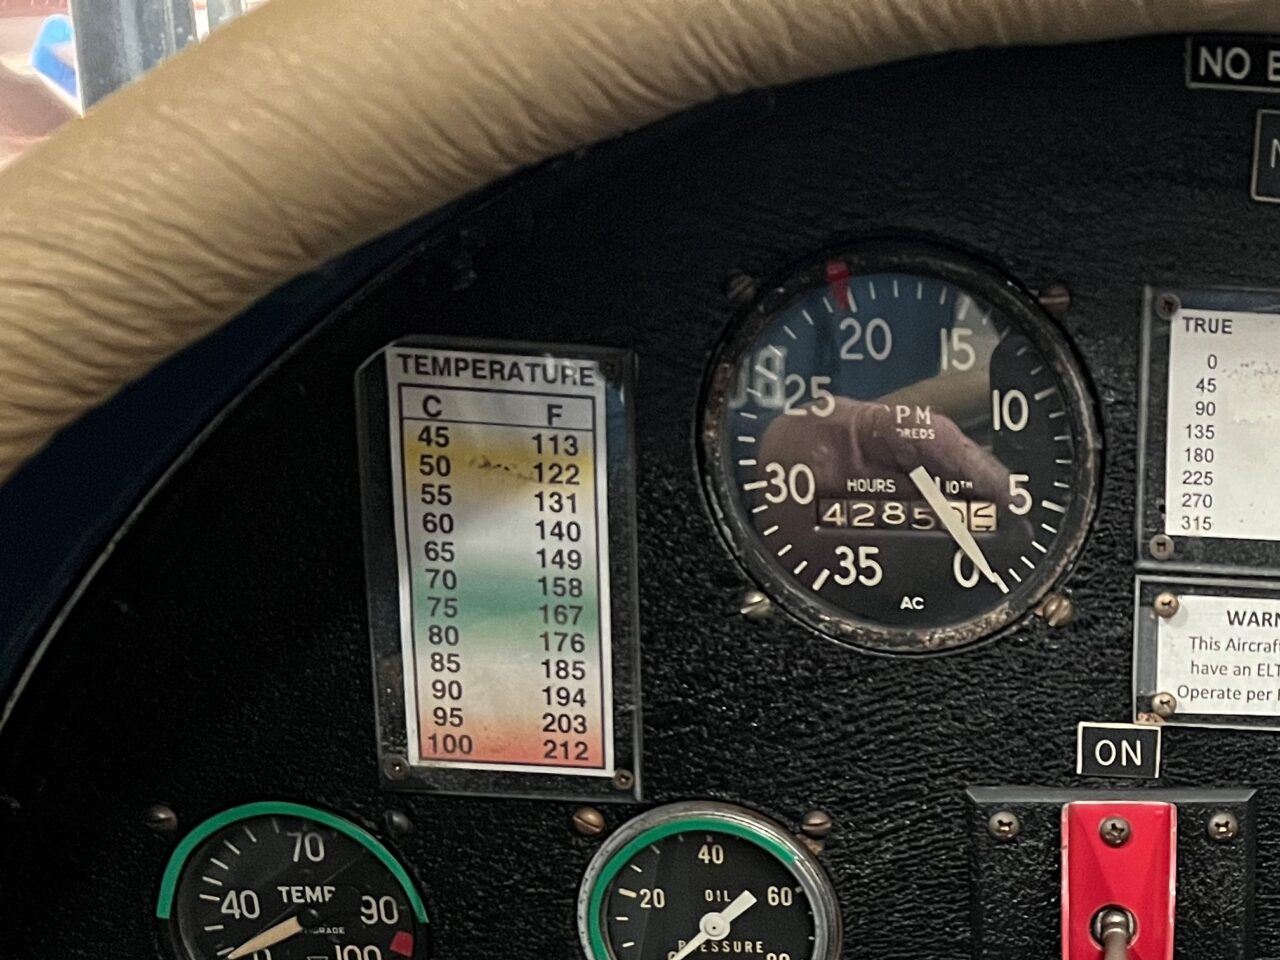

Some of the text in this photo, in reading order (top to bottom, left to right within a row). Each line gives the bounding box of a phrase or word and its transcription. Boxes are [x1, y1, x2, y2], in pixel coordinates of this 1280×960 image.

[1200, 47, 1251, 79] NO
[1182, 316, 1233, 334] TRUE
[840, 318, 892, 360] 20
[941, 328, 976, 371] 15
[398, 354, 594, 387] TEMPERATURE
[1207, 354, 1217, 369] 0
[784, 374, 835, 417] 25
[1196, 378, 1217, 393] 45
[422, 395, 563, 425] C F
[883, 404, 931, 425] PM
[992, 389, 1029, 431] 10
[1195, 401, 1216, 416] 90
[418, 426, 579, 456] 45 113
[1185, 424, 1215, 439] 135
[1185, 448, 1214, 463] 180
[419, 455, 580, 485] 50 122
[765, 462, 816, 505] 30
[1182, 471, 1213, 486] 225
[421, 484, 577, 514] 55 131
[847, 479, 896, 493] HOURS
[1009, 473, 1032, 515] 5
[1182, 493, 1213, 508] 270
[422, 513, 581, 542] 60 140
[1181, 516, 1212, 531] 315
[424, 542, 583, 571] 65 149
[834, 546, 883, 587] 35
[953, 548, 981, 588] 0
[425, 570, 583, 598] 70 158
[427, 598, 583, 625] 75 167
[900, 597, 924, 610] AC
[429, 626, 585, 653] 80 176
[1189, 636, 1221, 652] This
[430, 653, 586, 680] 85 185
[1190, 660, 1228, 676] have
[1233, 665, 1251, 677] an
[432, 681, 586, 708] 90 194
[1177, 685, 1241, 703] Operate
[1246, 690, 1270, 704] per
[433, 707, 587, 735] 95 203
[428, 735, 589, 761] 100 212
[1095, 739, 1142, 766] ON
[287, 832, 325, 862] 70
[698, 845, 724, 864] 40
[221, 890, 260, 919] 40
[640, 889, 665, 908] 20
[705, 890, 731, 902] OIL
[767, 887, 792, 906] 60
[361, 895, 398, 925] 90
[678, 940, 764, 953] PESSURE
